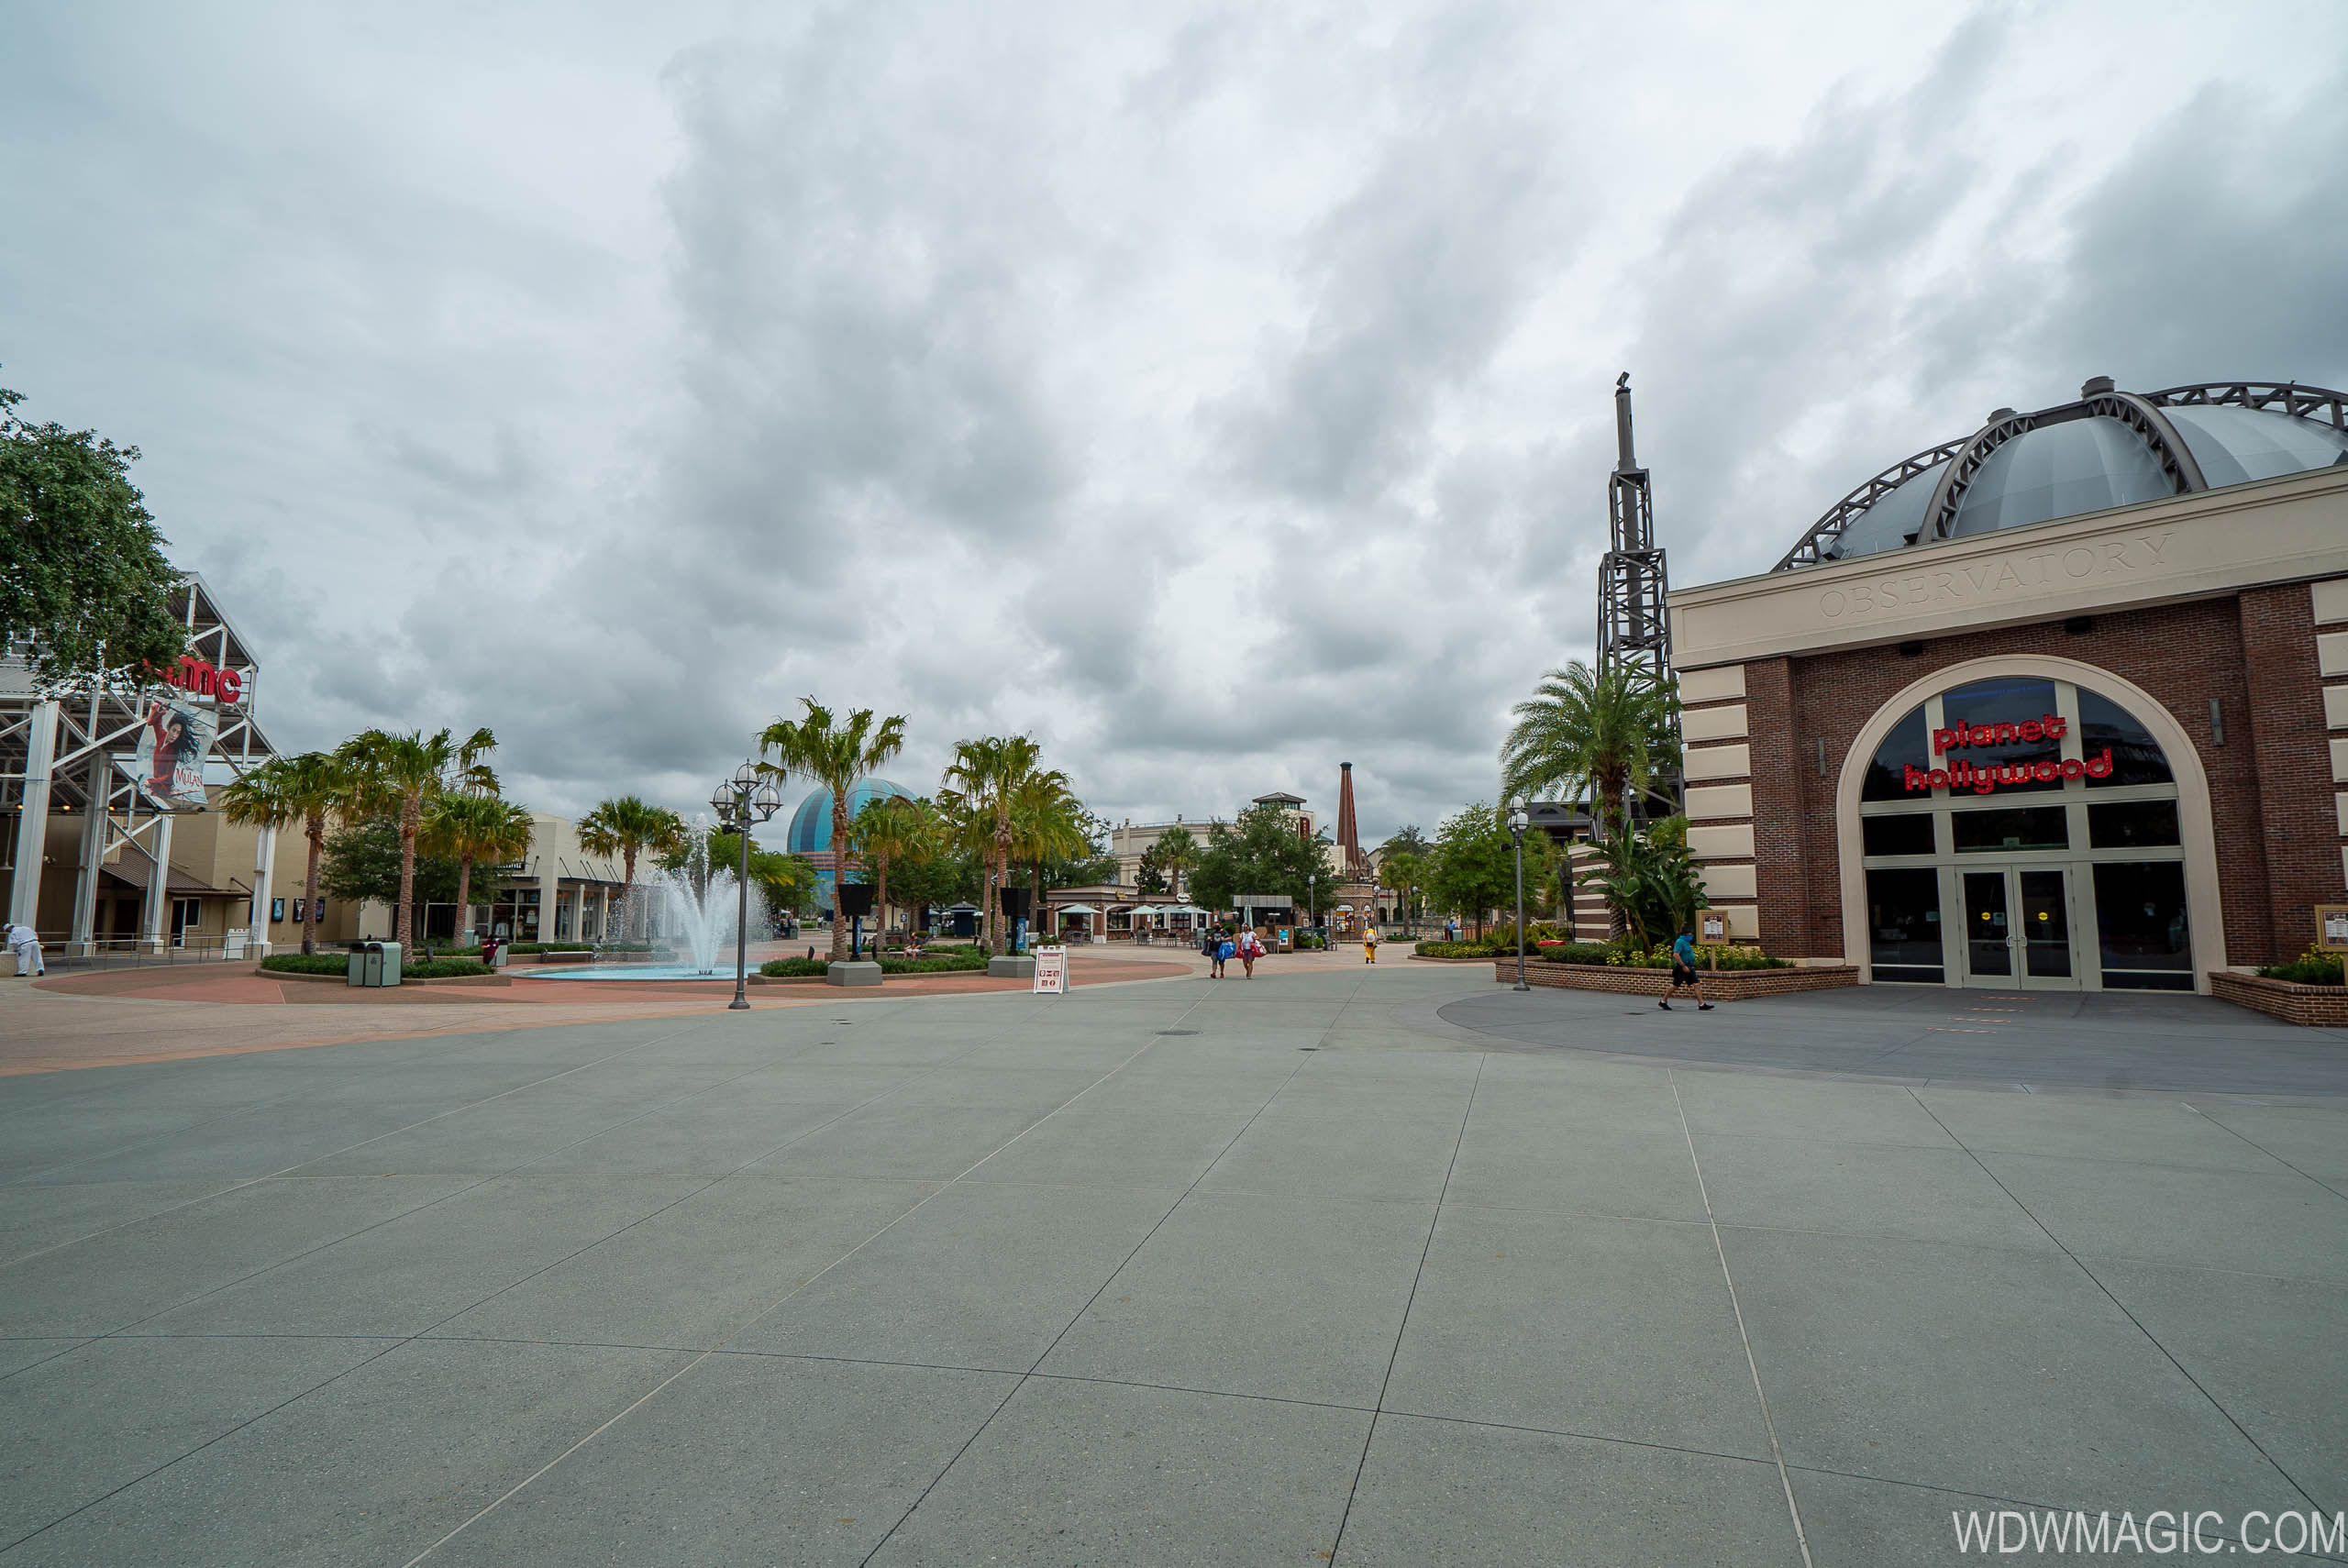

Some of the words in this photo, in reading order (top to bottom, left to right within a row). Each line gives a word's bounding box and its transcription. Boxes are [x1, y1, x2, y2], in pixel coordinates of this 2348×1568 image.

[1820, 532, 2175, 618] OBSERVATORY
[144, 655, 242, 703] mc
[1933, 713, 2066, 756] planet
[1903, 747, 2112, 794] hollywood
